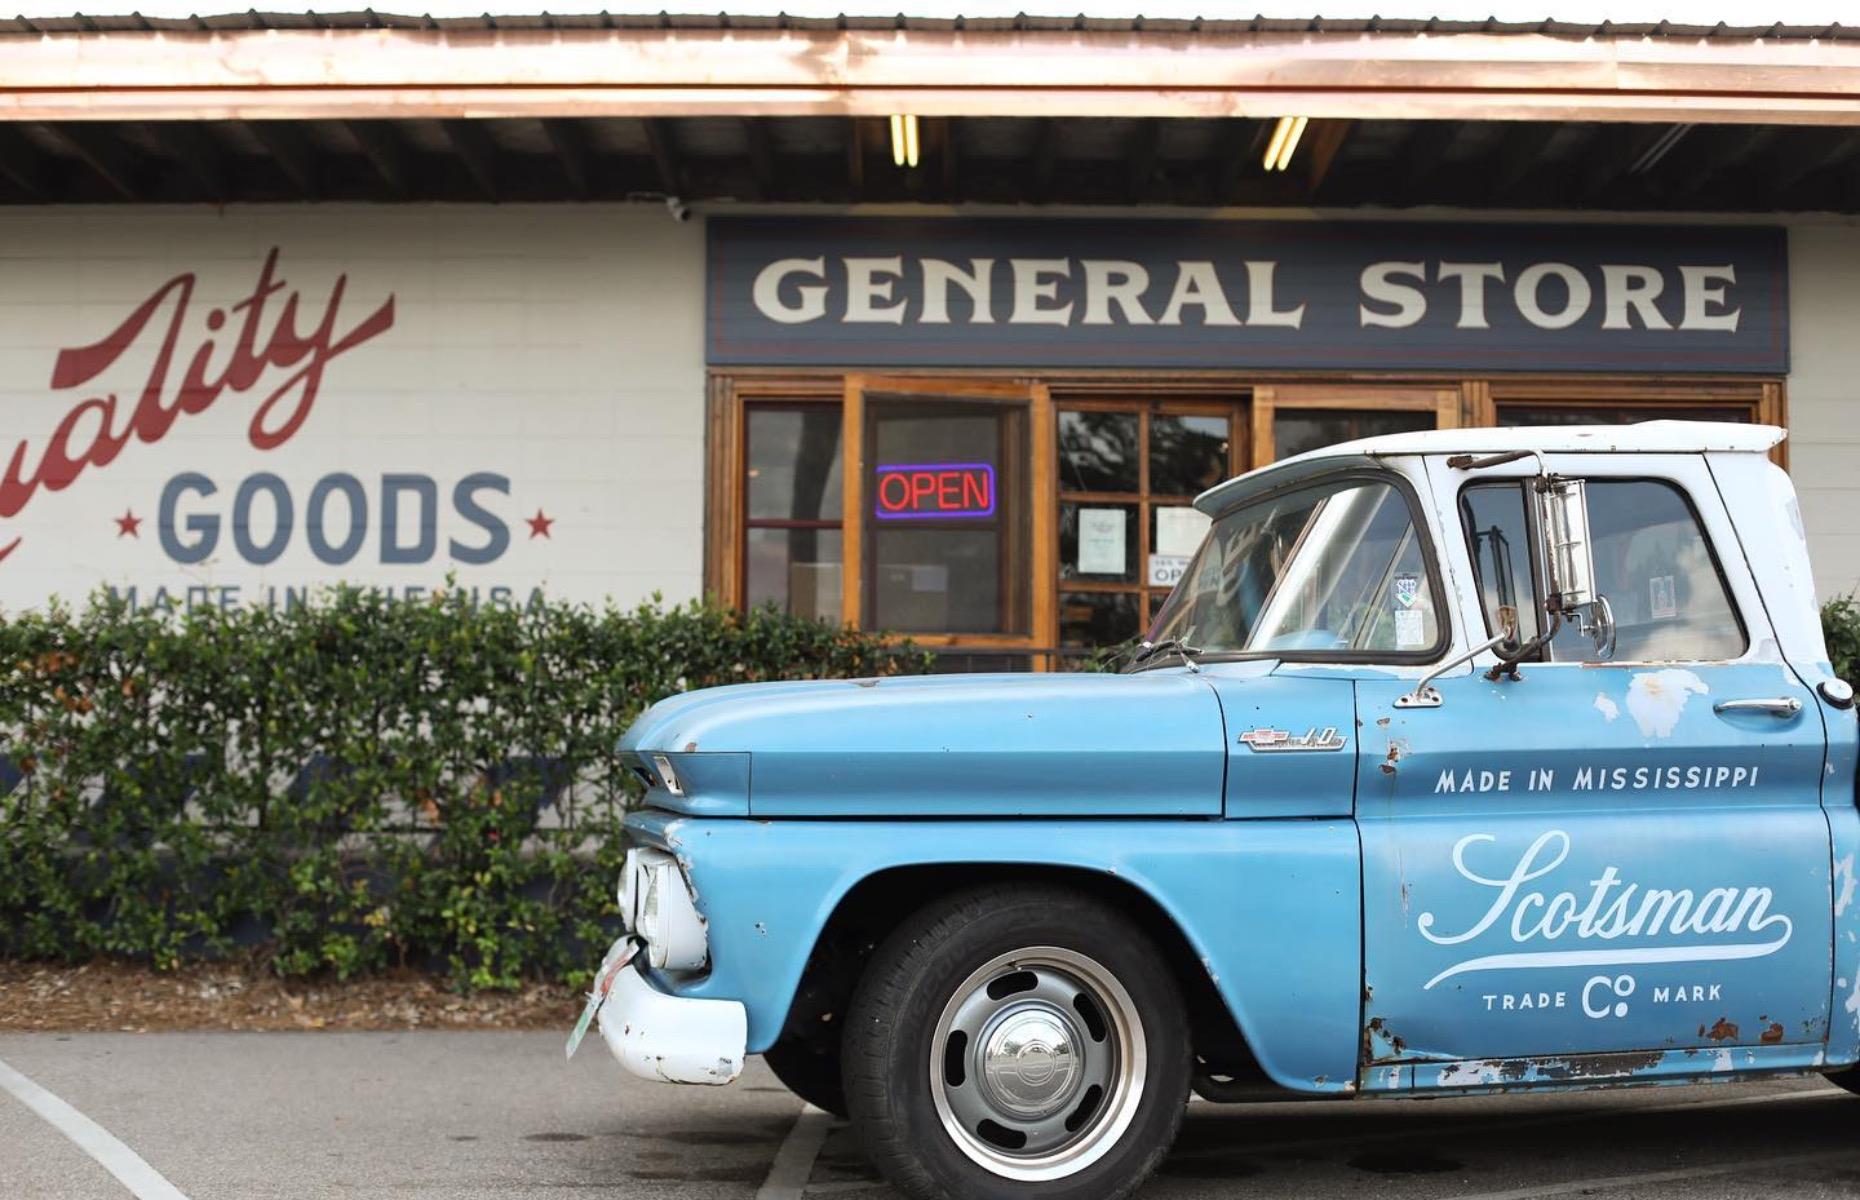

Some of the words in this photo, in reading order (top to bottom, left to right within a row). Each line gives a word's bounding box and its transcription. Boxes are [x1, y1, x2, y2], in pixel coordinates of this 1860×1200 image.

[753, 255, 1306, 330] GENERAL
[1360, 261, 1743, 334] STORE
[0, 246, 394, 560] ality
[158, 472, 511, 565] GOODS
[879, 471, 989, 512] OPEN
[1301, 727, 1337, 745] 10
[1434, 768, 1512, 794] MADE
[1528, 769, 1554, 793] IN
[1572, 765, 1760, 792] MISSISSIPPI
[1417, 829, 1793, 945] Scotsman
[1482, 991, 1567, 1011] TRADE
[1653, 984, 1722, 1003] MARK
